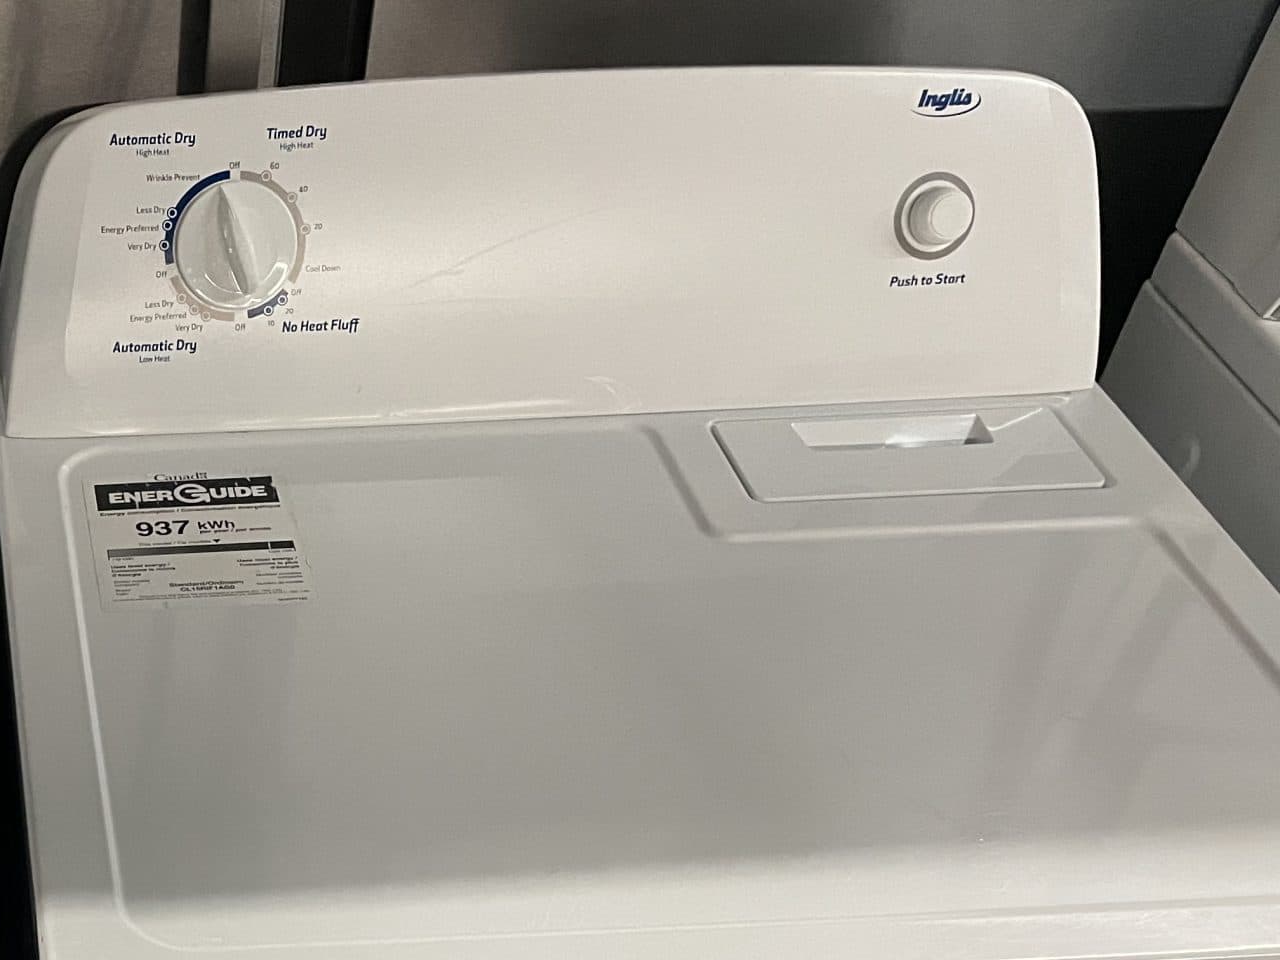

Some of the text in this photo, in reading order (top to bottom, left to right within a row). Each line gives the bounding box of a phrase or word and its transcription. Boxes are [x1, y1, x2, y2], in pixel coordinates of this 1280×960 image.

[918, 88, 972, 111] Inglis
[266, 126, 328, 140] Timed Dry
[110, 132, 196, 147] Automatic Dry
[280, 141, 314, 152] High Heat
[136, 148, 170, 158] High Heat
[229, 161, 240, 170] Off
[270, 162, 280, 170] 60
[146, 173, 200, 182] Wrinkle Prevent
[136, 206, 166, 216] Less Dry
[100, 224, 159, 235] Energy Preferred
[127, 242, 156, 252] Very Dry
[305, 264, 320, 272] Cool
[155, 270, 168, 278] Off
[889, 273, 966, 287] Push to Start
[291, 288, 302, 296] Off
[145, 300, 174, 310] Less Dry
[130, 312, 187, 324] Energy Preferred
[175, 323, 203, 333] Very Dry
[234, 323, 246, 332] Off
[282, 318, 360, 333] No Heat Fluff
[112, 339, 198, 354] Automatic Dry
[139, 355, 170, 364] Low Heat
[135, 520, 236, 537] 937 kWh
